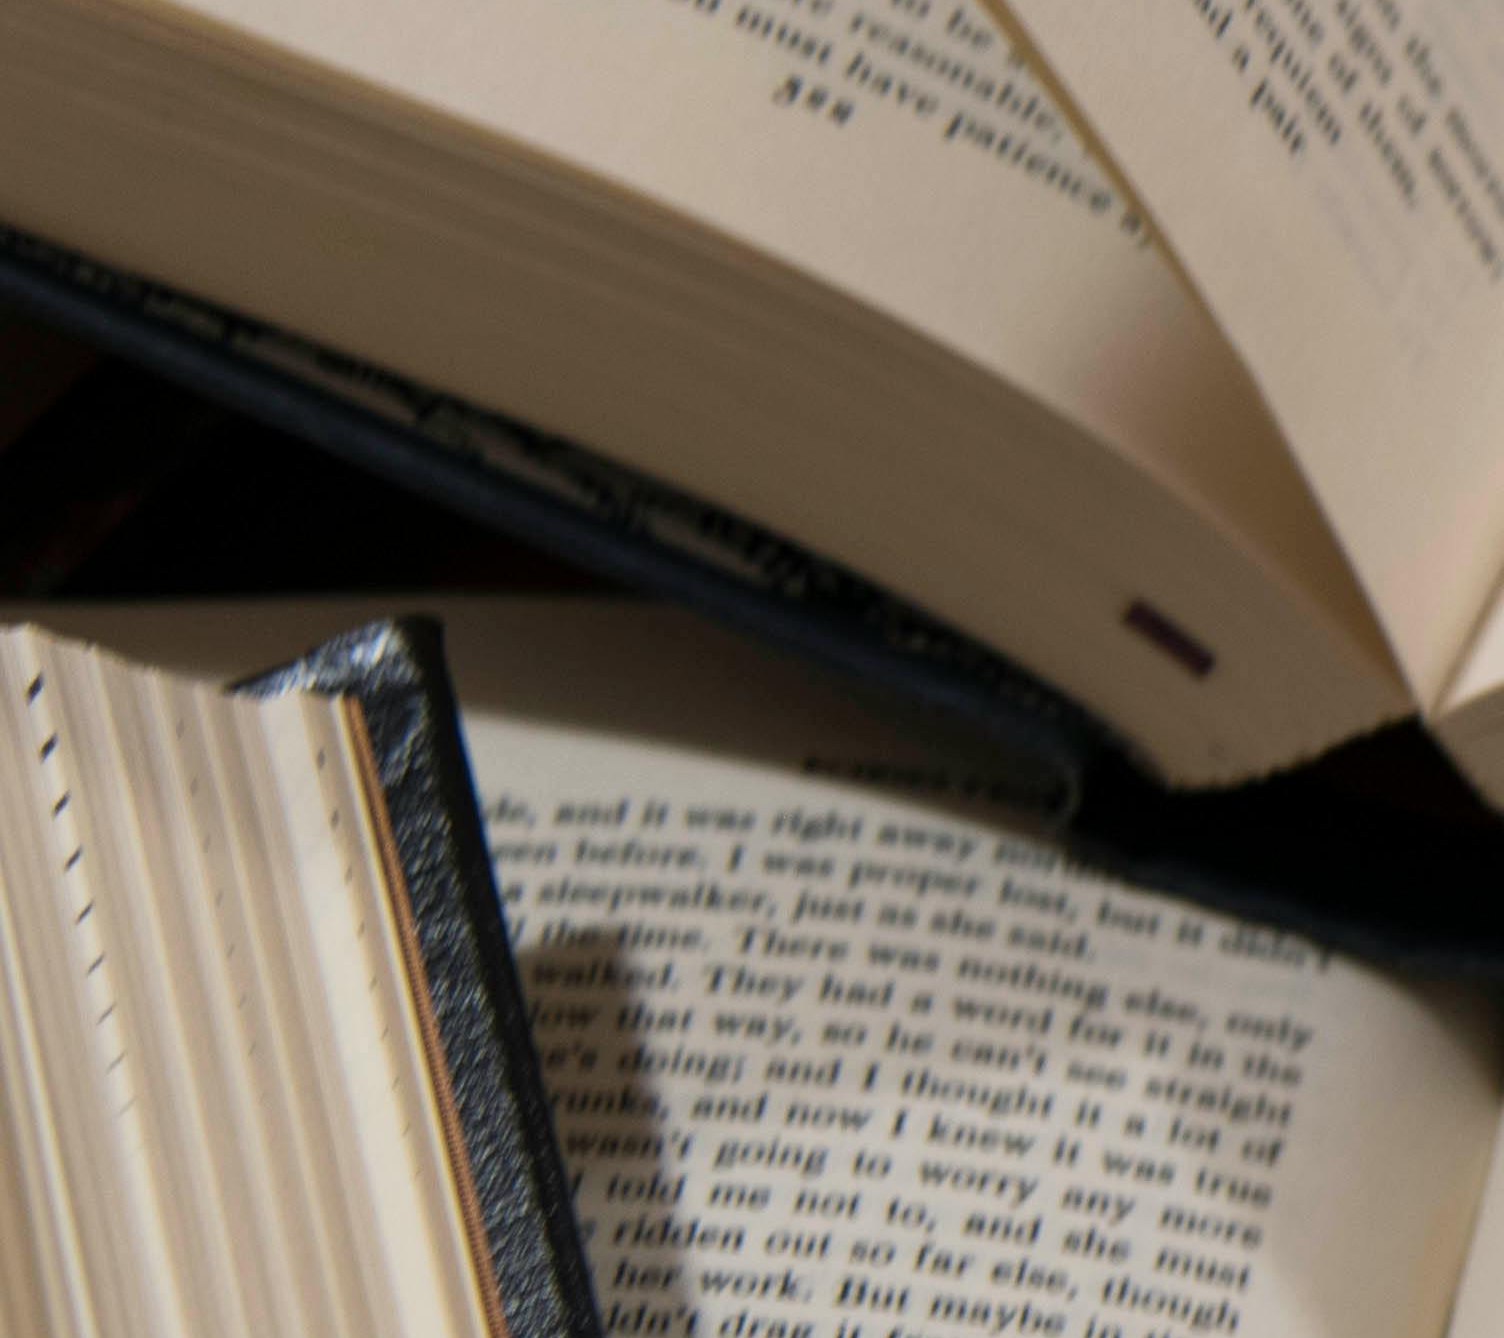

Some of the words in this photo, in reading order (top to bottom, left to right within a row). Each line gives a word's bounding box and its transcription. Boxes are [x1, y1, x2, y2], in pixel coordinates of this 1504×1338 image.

[734, 4, 834, 67] must
[843, 50, 939, 115] have
[941, 110, 1113, 213] patience
[1230, 43, 1252, 75] a
[1247, 76, 1307, 157] pair
